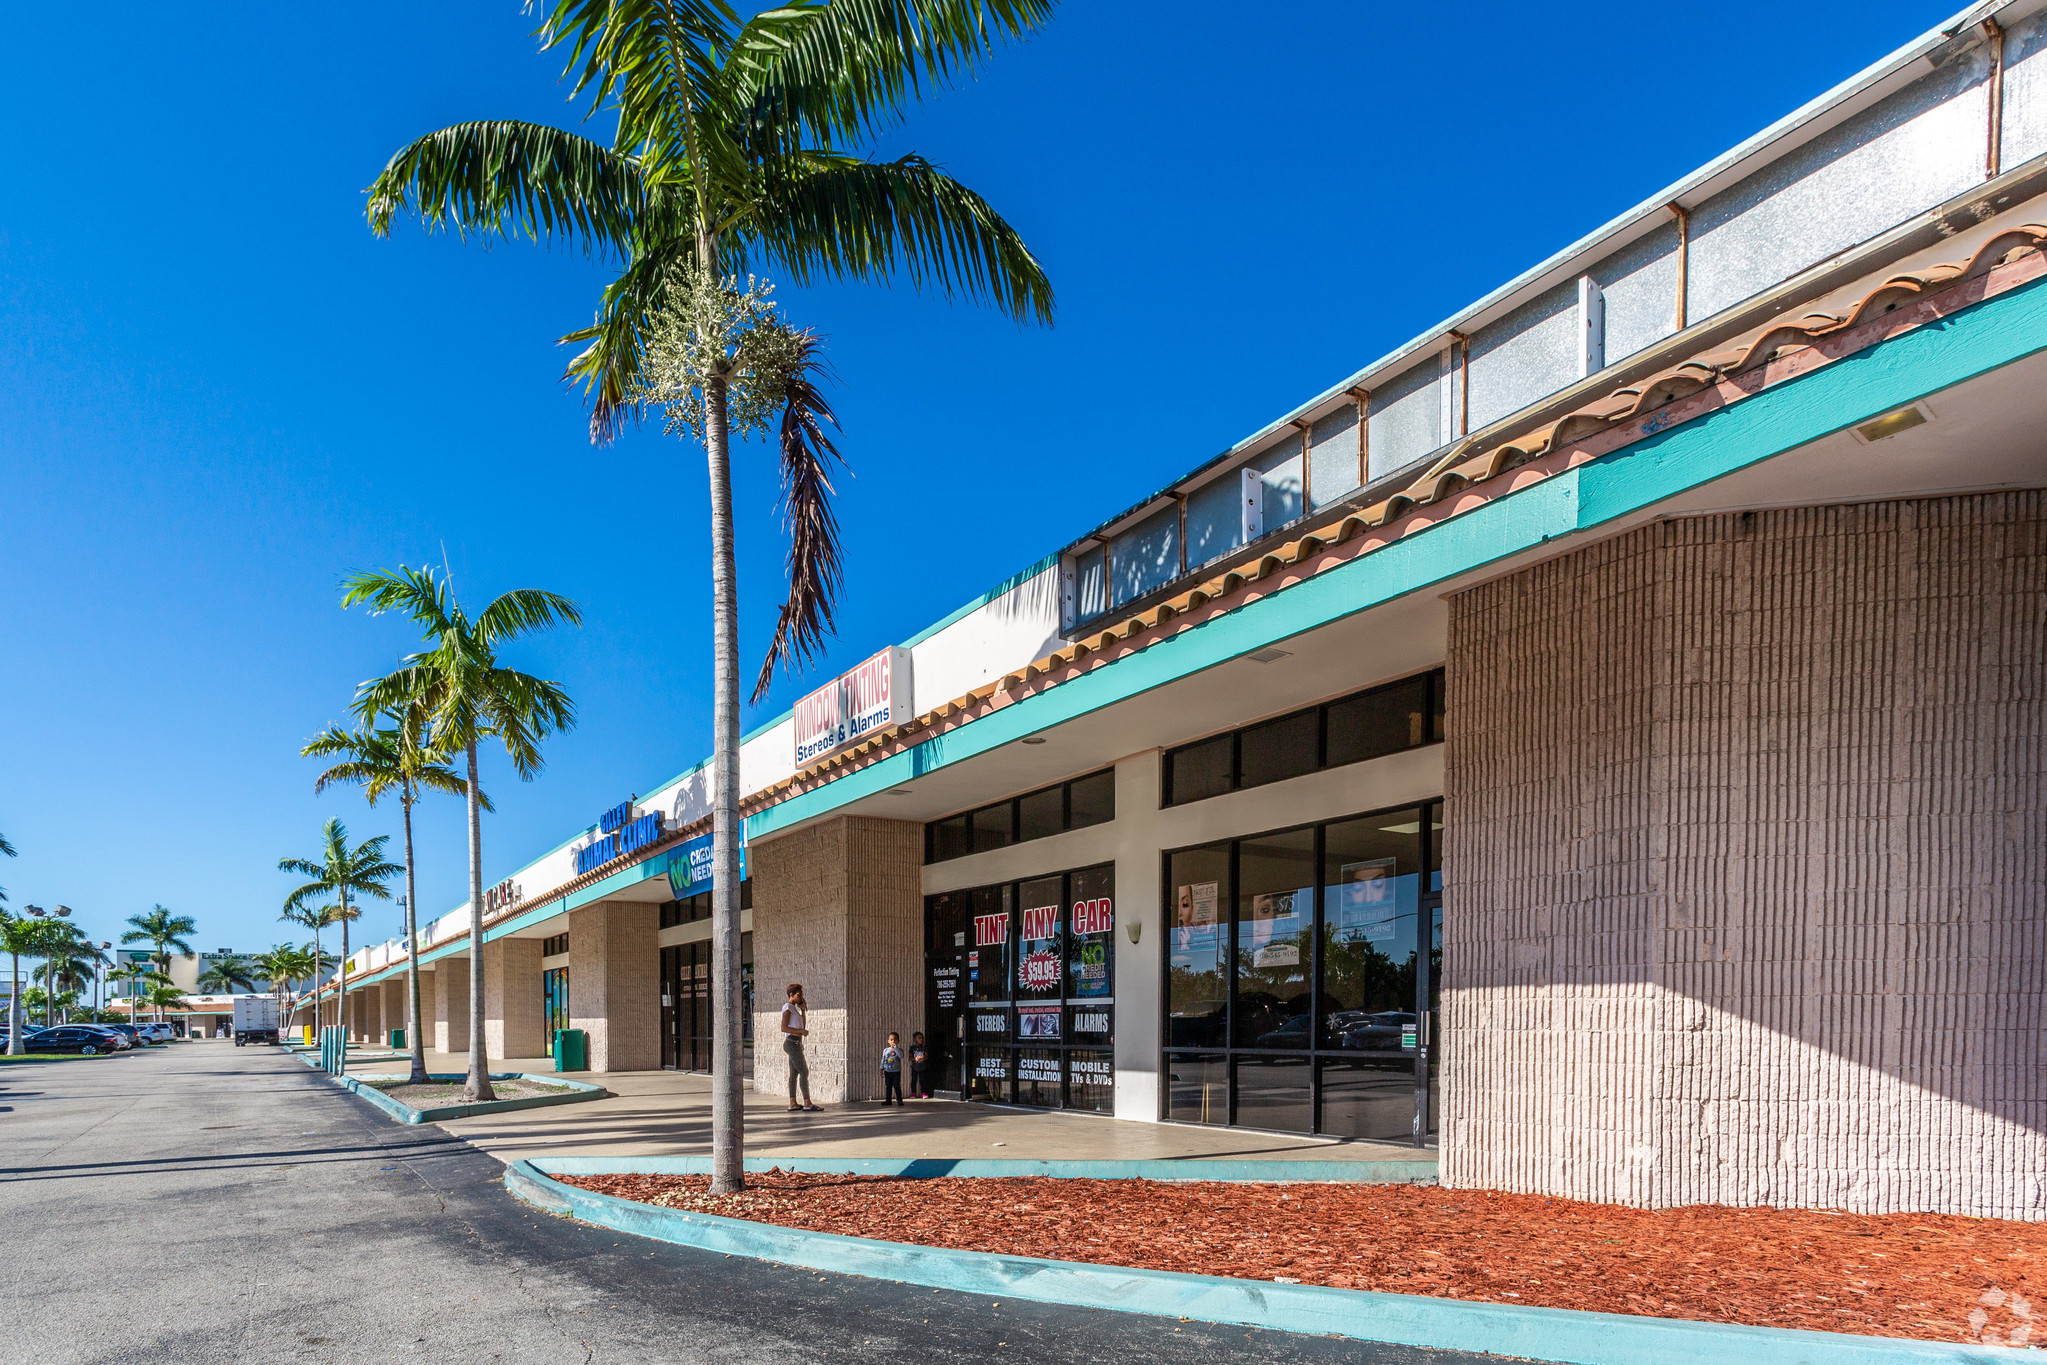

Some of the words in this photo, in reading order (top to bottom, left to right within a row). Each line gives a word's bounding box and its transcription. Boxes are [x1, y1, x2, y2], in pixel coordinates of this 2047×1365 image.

[796, 681, 840, 744] WINDOW
[844, 655, 889, 720] TINTING
[797, 734, 835, 762] Stereos
[838, 724, 846, 742] &
[850, 707, 890, 737] Alarms
[600, 801, 628, 834] GILLEY
[577, 833, 617, 877] ANIMAL
[620, 810, 660, 855] CLINIC
[670, 854, 691, 890] NO
[690, 845, 714, 866] CREDI
[691, 862, 714, 882] NEED
[974, 912, 1009, 946] TINT
[1022, 905, 1058, 941] ANY
[1072, 898, 1111, 935] CAR
[1081, 944, 1105, 965] NO
[1027, 959, 1055, 981] $59.95
[1080, 962, 1105, 973] CREDIT
[1080, 971, 1106, 980] NEEDED
[976, 1014, 1005, 1032] STEREOS
[1074, 1013, 1108, 1033] ALARMS
[976, 1067, 1005, 1078] PRICES
[980, 1058, 1001, 1068] BEST
[1020, 1058, 1058, 1070] CUSTOM
[1071, 1061, 1110, 1074] MOBILE
[1018, 1068, 1061, 1082] INSTALLATION
[1071, 1073, 1083, 1084] TVs
[1085, 1073, 1091, 1084] &
[1093, 1073, 1112, 1086] DVDs
